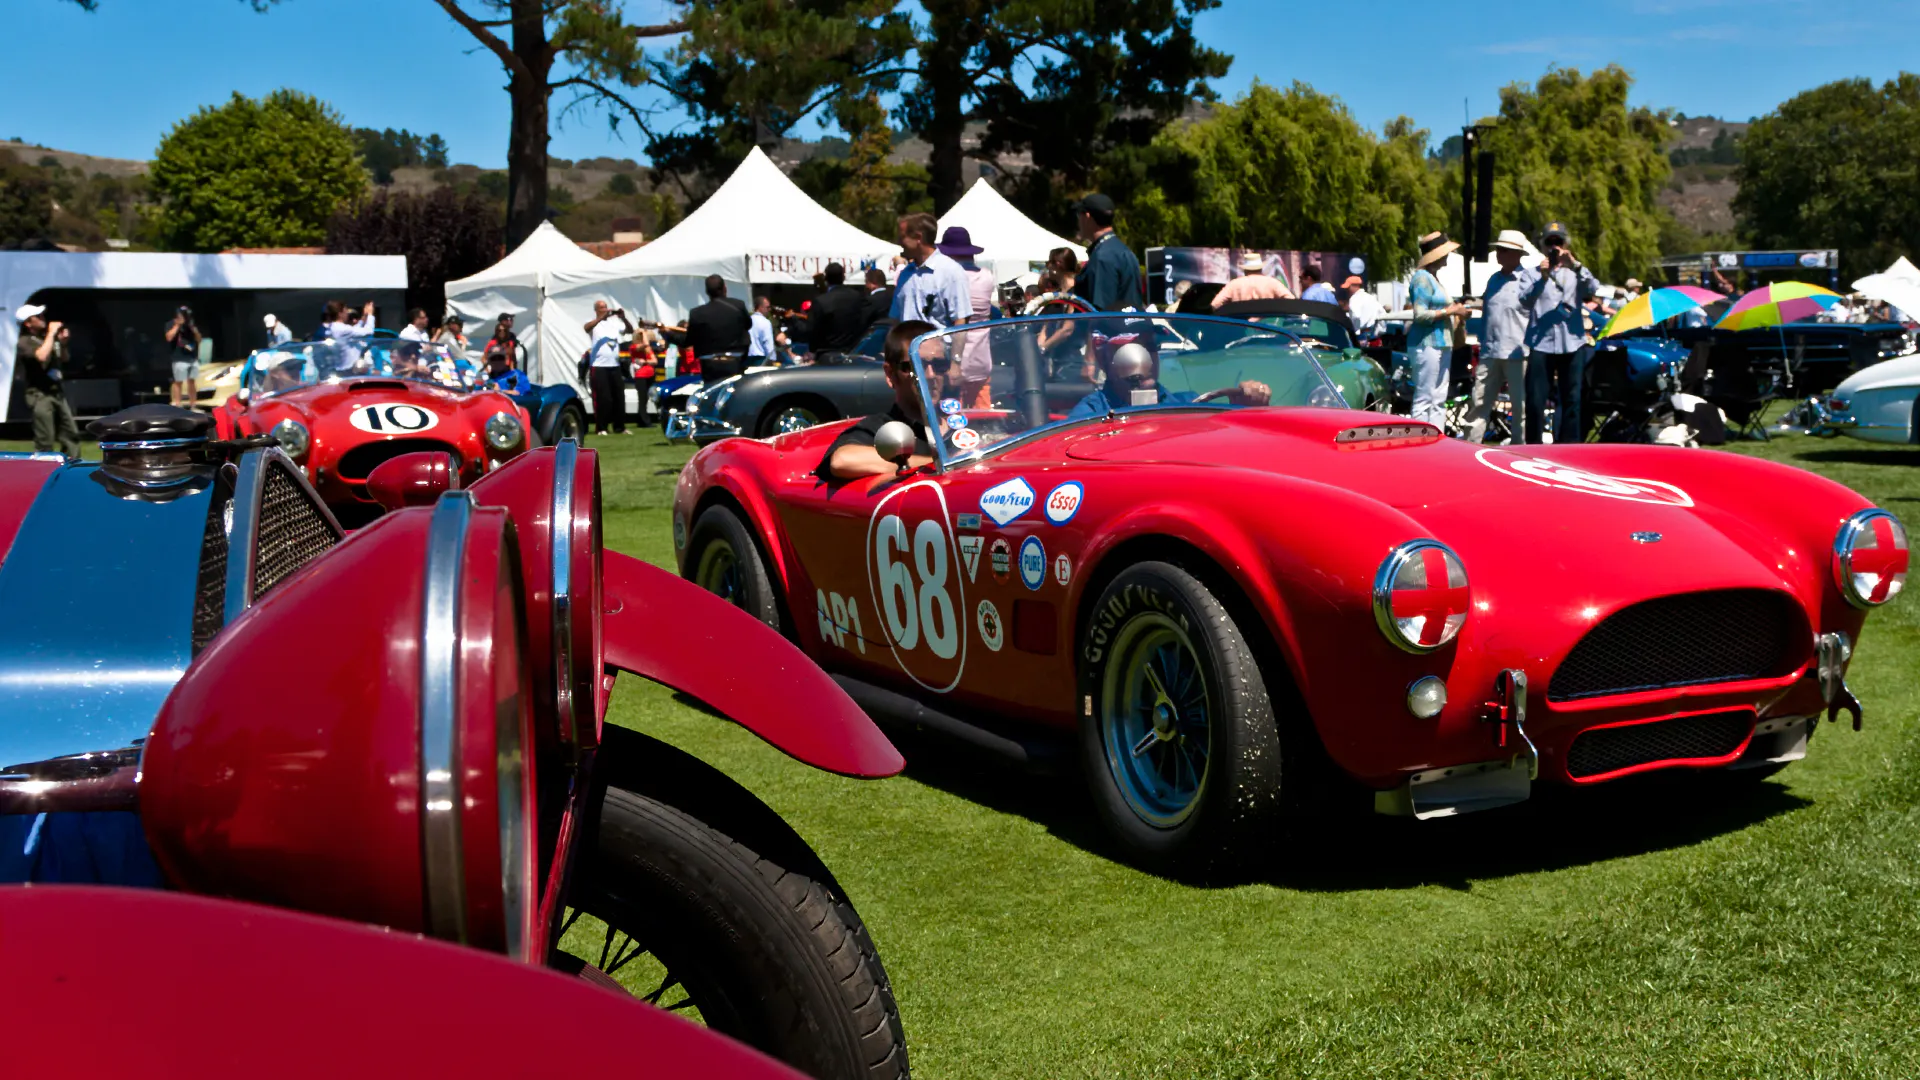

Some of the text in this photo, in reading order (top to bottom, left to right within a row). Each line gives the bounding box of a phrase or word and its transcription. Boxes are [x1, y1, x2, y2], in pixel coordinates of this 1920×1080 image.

[755, 254, 797, 273] THE
[366, 405, 430, 431] 10
[1050, 491, 1077, 511] ESSO
[1024, 553, 1041, 573] PURE
[1057, 558, 1068, 582] E
[876, 514, 959, 660] 68
